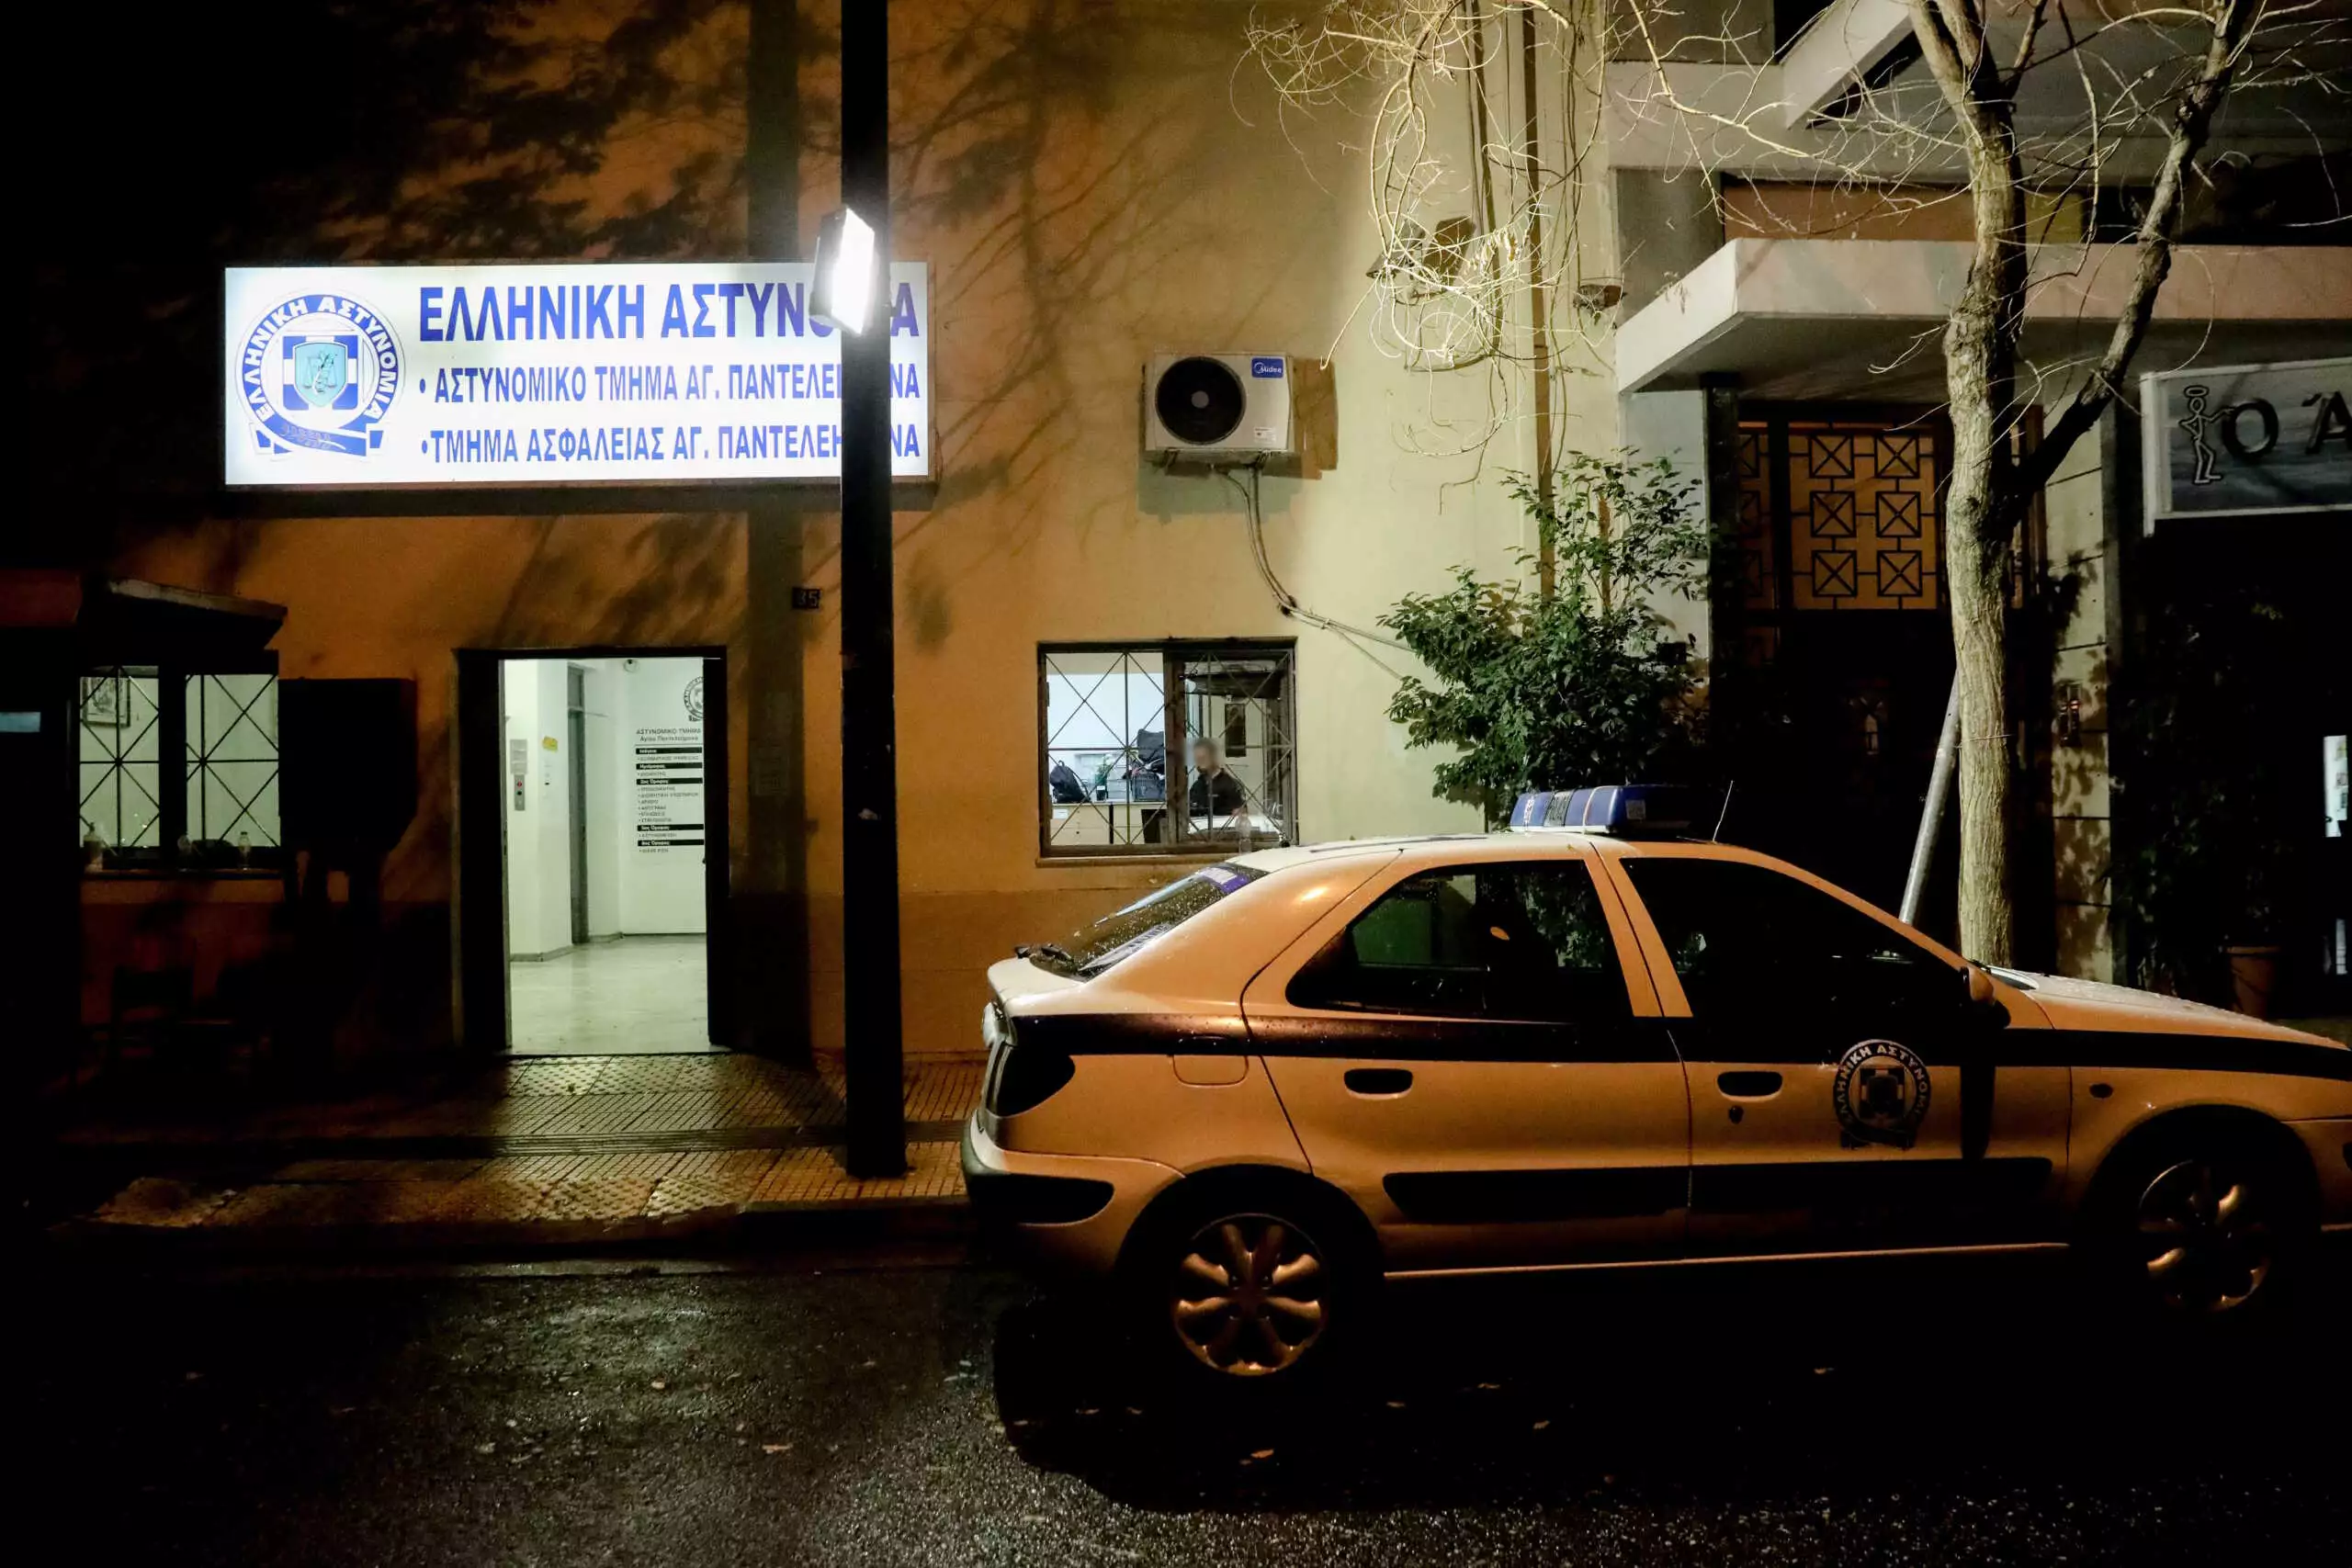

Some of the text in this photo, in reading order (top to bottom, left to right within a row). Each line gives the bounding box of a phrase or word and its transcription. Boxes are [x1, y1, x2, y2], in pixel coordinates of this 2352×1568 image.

[420, 282, 920, 343] ΕΛΛΗΝΙΚΗ ΑΣΤΥΝΑ
[243, 296, 398, 422] ΕΛΛΗΝΙΚΗ ΑΣΤΥΝΟΜΙΑ
[435, 363, 921, 403] ΑΣΤΥΝΟΜΙΚΟ ΤΜΗΜΑ ΑΓ. ΠΑΝΤΕΛΕΝΑ
[430, 423, 921, 463] ΤΜΗΜΑ ΑΣΦΑΛΕΙΑΣ ΑΓ. ΠΑΝΤΕΛΕΗΝΑ
